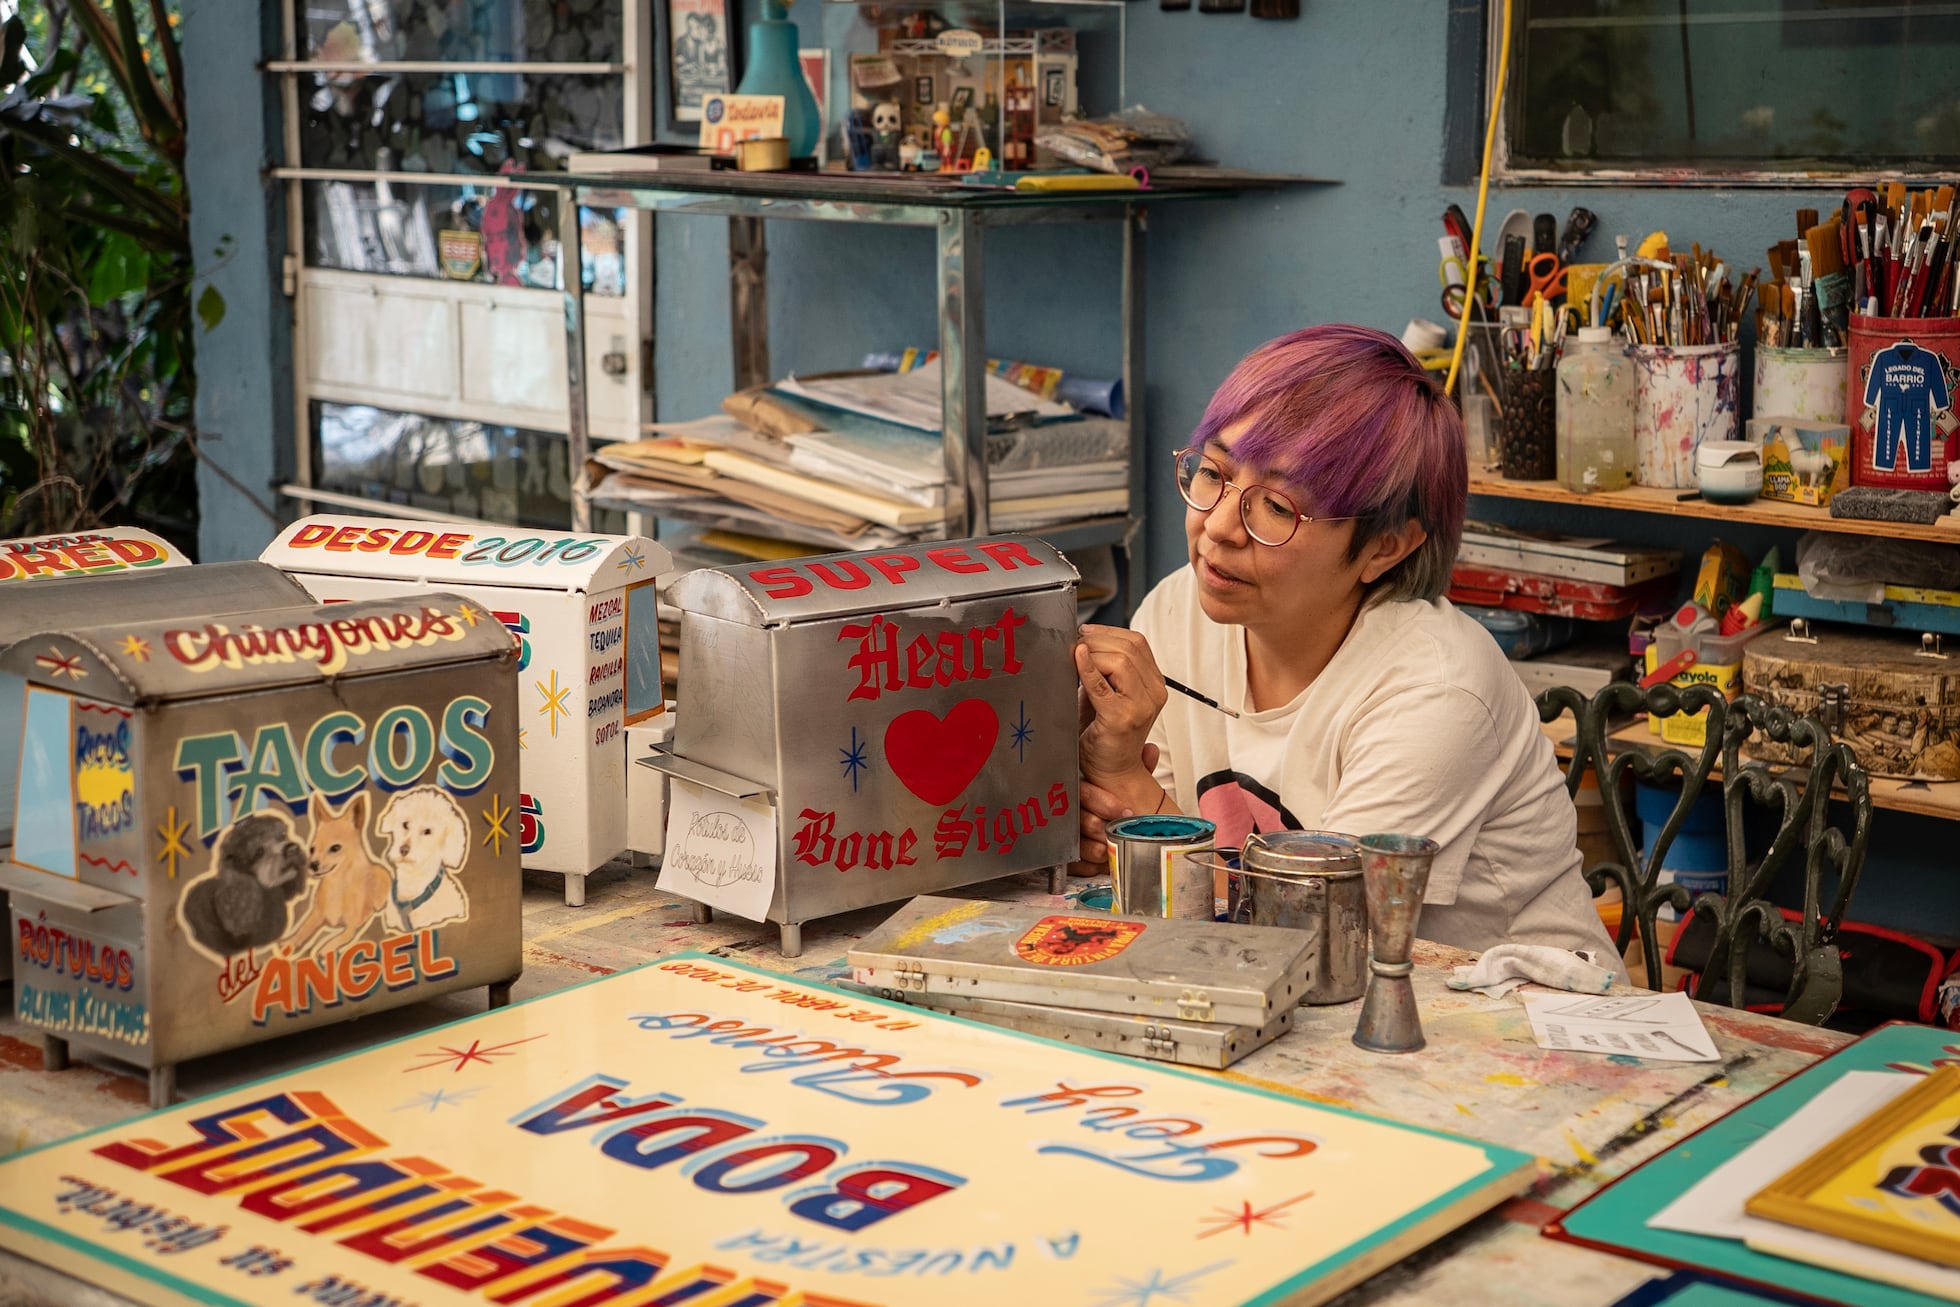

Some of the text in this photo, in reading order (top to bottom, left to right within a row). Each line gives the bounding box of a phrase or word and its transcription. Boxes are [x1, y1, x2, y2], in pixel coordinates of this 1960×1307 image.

[1885, 365, 1925, 376] LEGADO DEL
[1886, 374, 1925, 384] BARRIO
[289, 524, 613, 568] DESDE 2016
[748, 541, 1044, 600] SUPER
[589, 597, 624, 625] MEZCAL
[162, 605, 464, 676] Chingones
[589, 626, 624, 655] TEQUILA
[837, 607, 1028, 702] Heart
[589, 657, 623, 687] RAICILLA
[1672, 671, 1718, 683] ayola
[588, 688, 623, 718] BACANORA
[595, 720, 620, 747] SOTOL
[172, 695, 496, 848] TACOS
[76, 789, 134, 842] TACOS
[792, 782, 1070, 872] Bone Signs
[18, 909, 134, 991] RÓTULOS
[1048, 947, 1119, 966] PINTURA
[217, 928, 462, 1027] del ÁNGEL
[658, 962, 921, 1031] 17 DE ABRIL DE 2026
[628, 1013, 982, 1107] Alonso
[507, 1073, 969, 1232] BODA
[714, 1228, 1080, 1278] A NUESTRA
